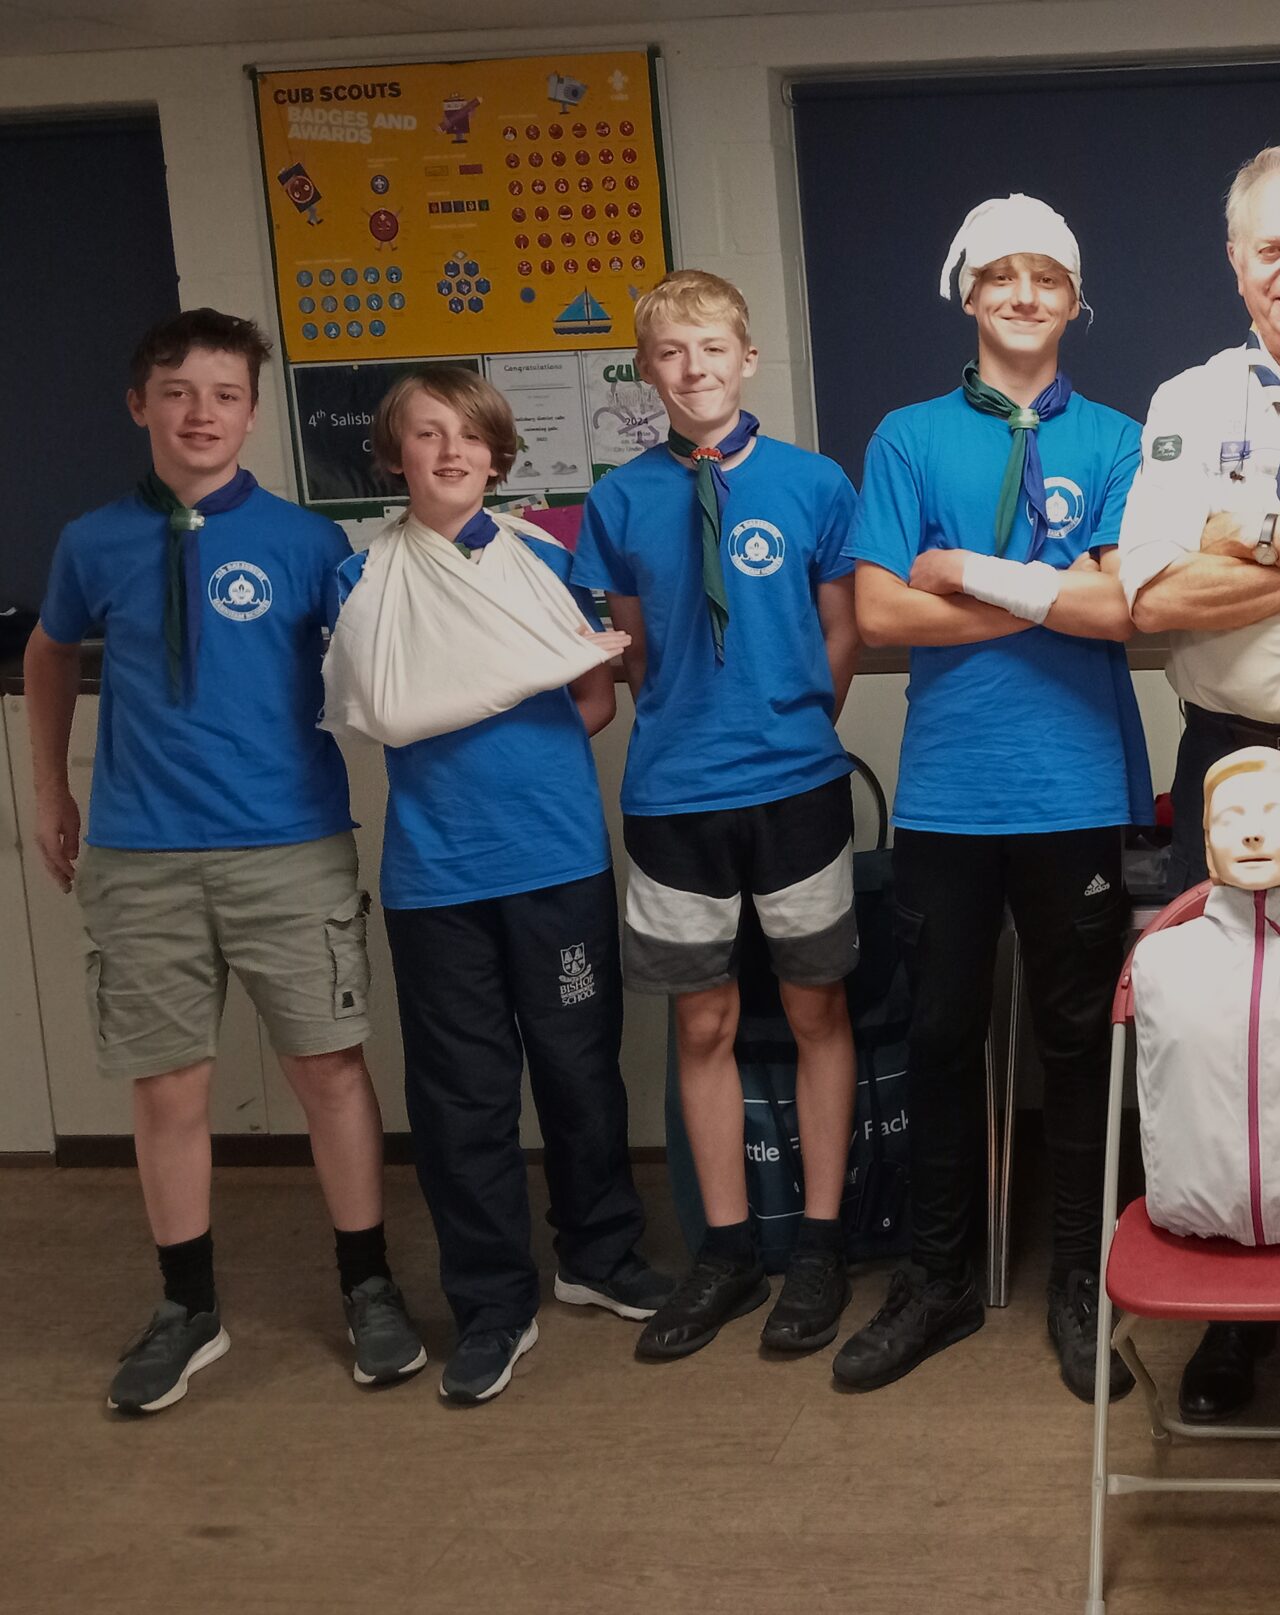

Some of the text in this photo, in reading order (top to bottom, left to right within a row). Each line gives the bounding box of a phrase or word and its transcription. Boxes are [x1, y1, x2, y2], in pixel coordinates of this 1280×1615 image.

[273, 82, 402, 105] CUB SCOUTS
[287, 106, 417, 130] BADGES AND
[287, 124, 373, 144] AWARDS
[503, 363, 563, 374] Congratulations
[308, 409, 326, 428] 4th
[625, 417, 649, 426] 2024
[559, 973, 594, 994] BISHOP
[561, 987, 596, 1006] SCHOOL
